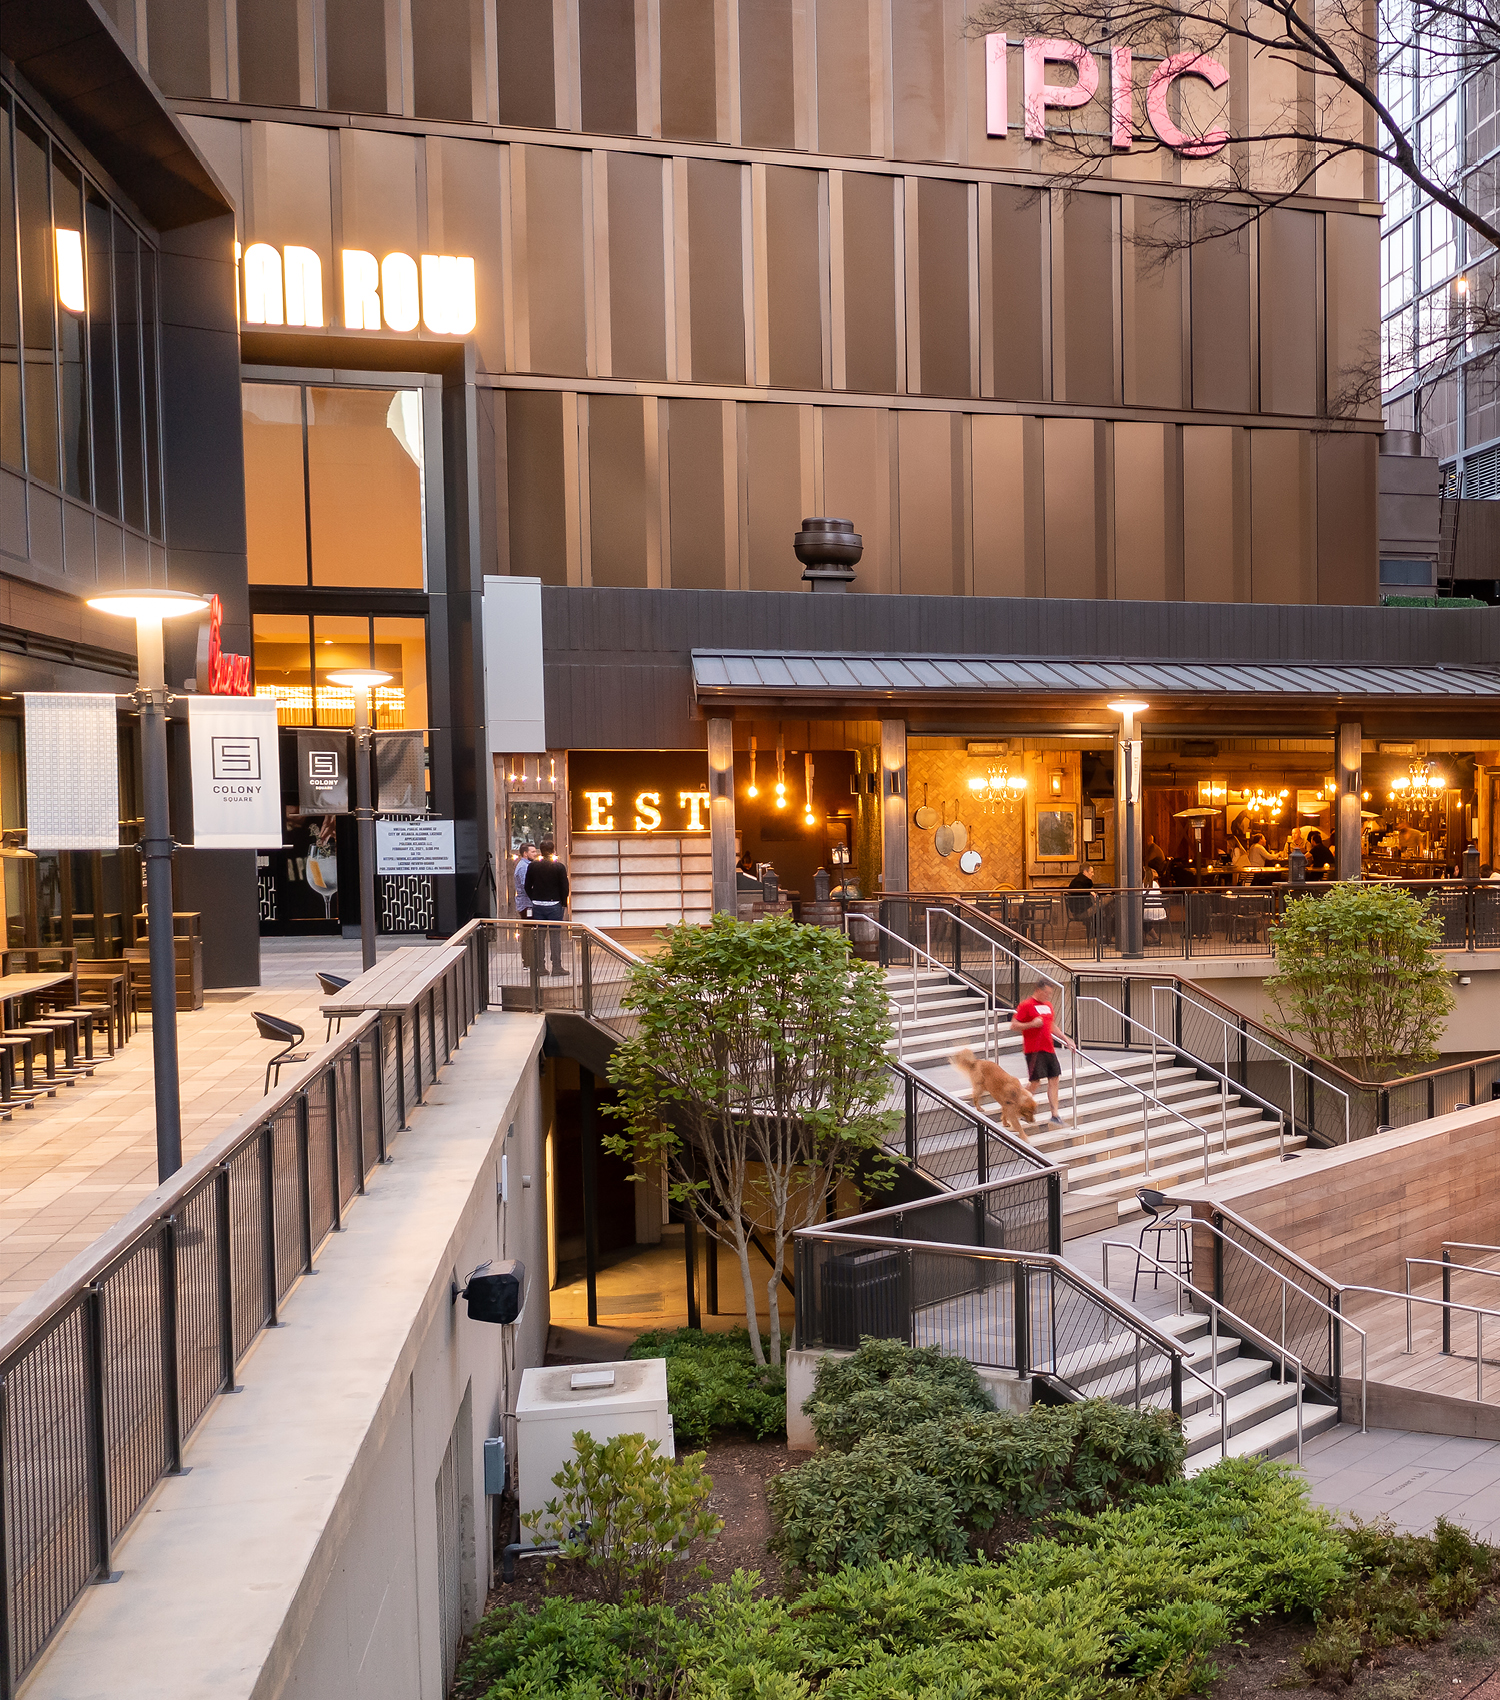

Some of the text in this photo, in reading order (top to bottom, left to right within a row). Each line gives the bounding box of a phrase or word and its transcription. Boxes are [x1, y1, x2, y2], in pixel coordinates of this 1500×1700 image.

[984, 33, 1230, 156] IPIC
[342, 249, 477, 335] ROW
[213, 785, 262, 794] COLONY
